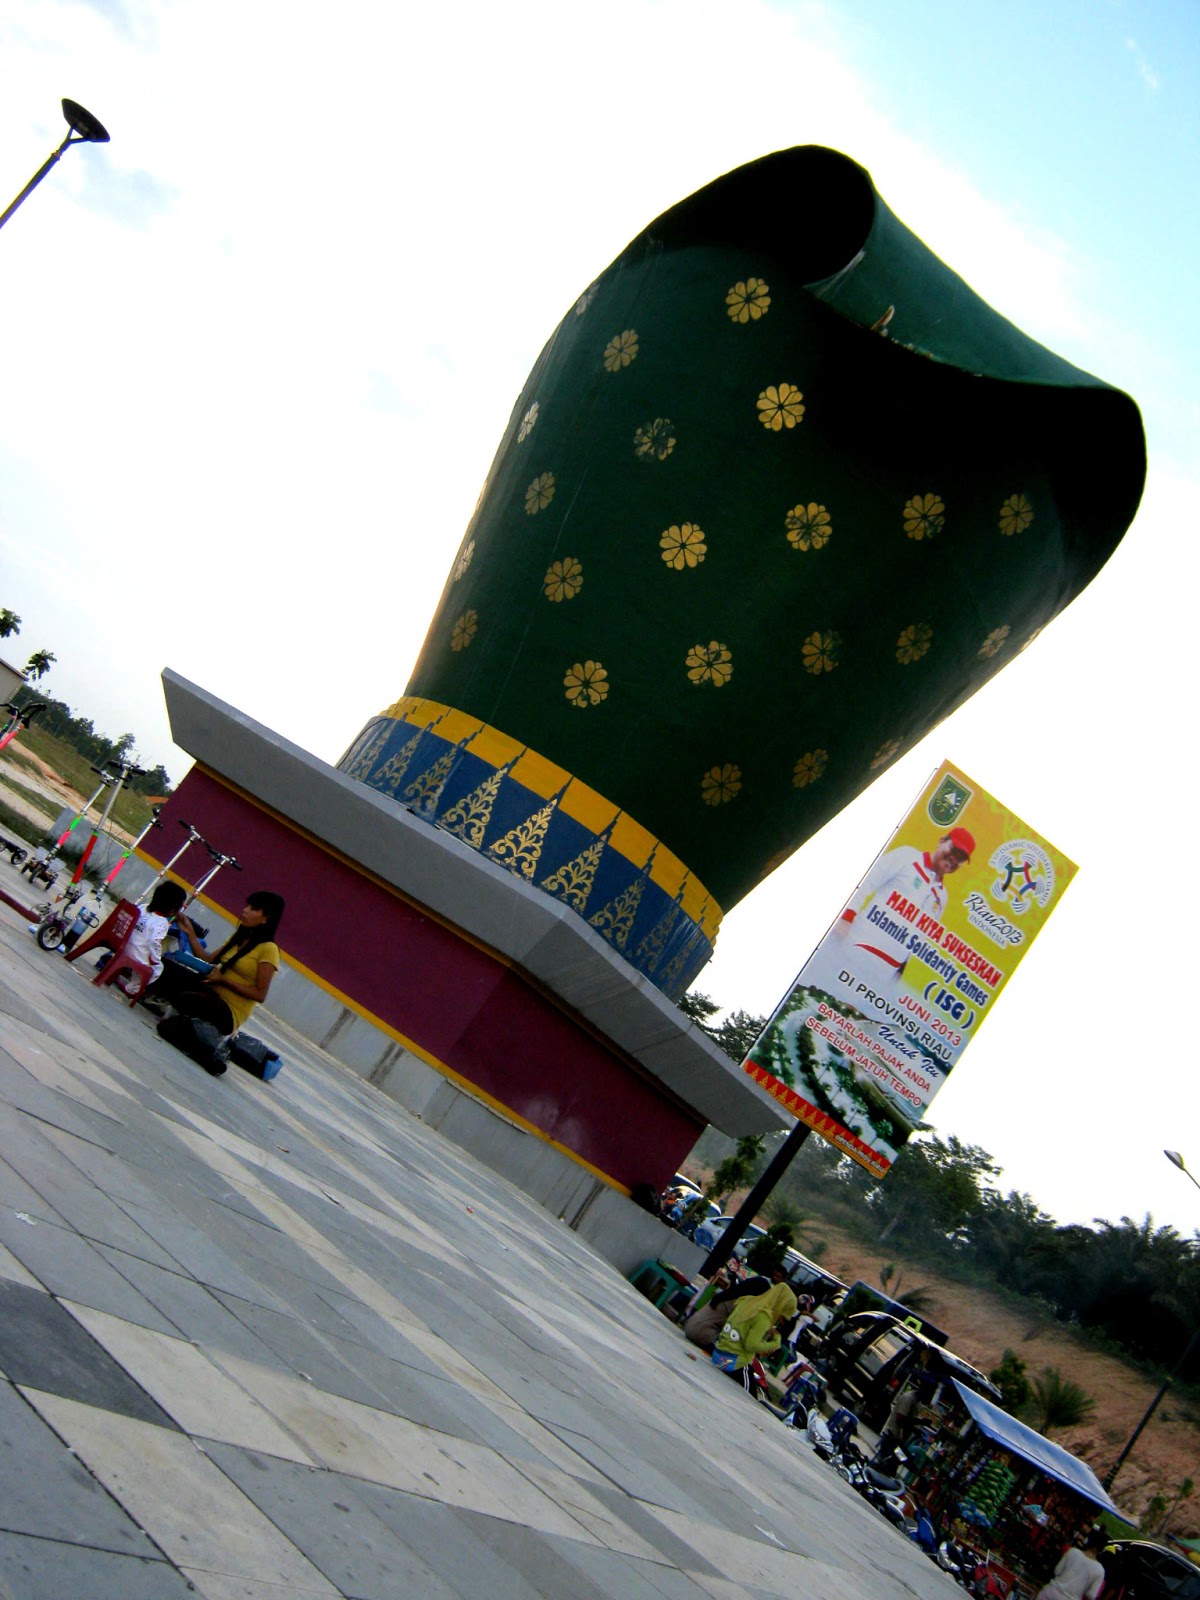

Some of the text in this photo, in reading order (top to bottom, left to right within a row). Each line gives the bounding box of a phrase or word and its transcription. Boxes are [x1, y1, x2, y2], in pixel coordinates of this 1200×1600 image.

[865, 904, 989, 1007] Islamik Solidarity Games
[885, 889, 1003, 988] MARI KITA SUKSESKAN
[817, 1003, 931, 1092] BAYARLAH PAJAK ANDA
[837, 969, 952, 1060] DI PROVINSI RIAU
[877, 1024, 919, 1060] Untuk
[897, 992, 962, 1046] JUNI 2013
[805, 1016, 922, 1107] SEBELUM JATUH TEMPO
